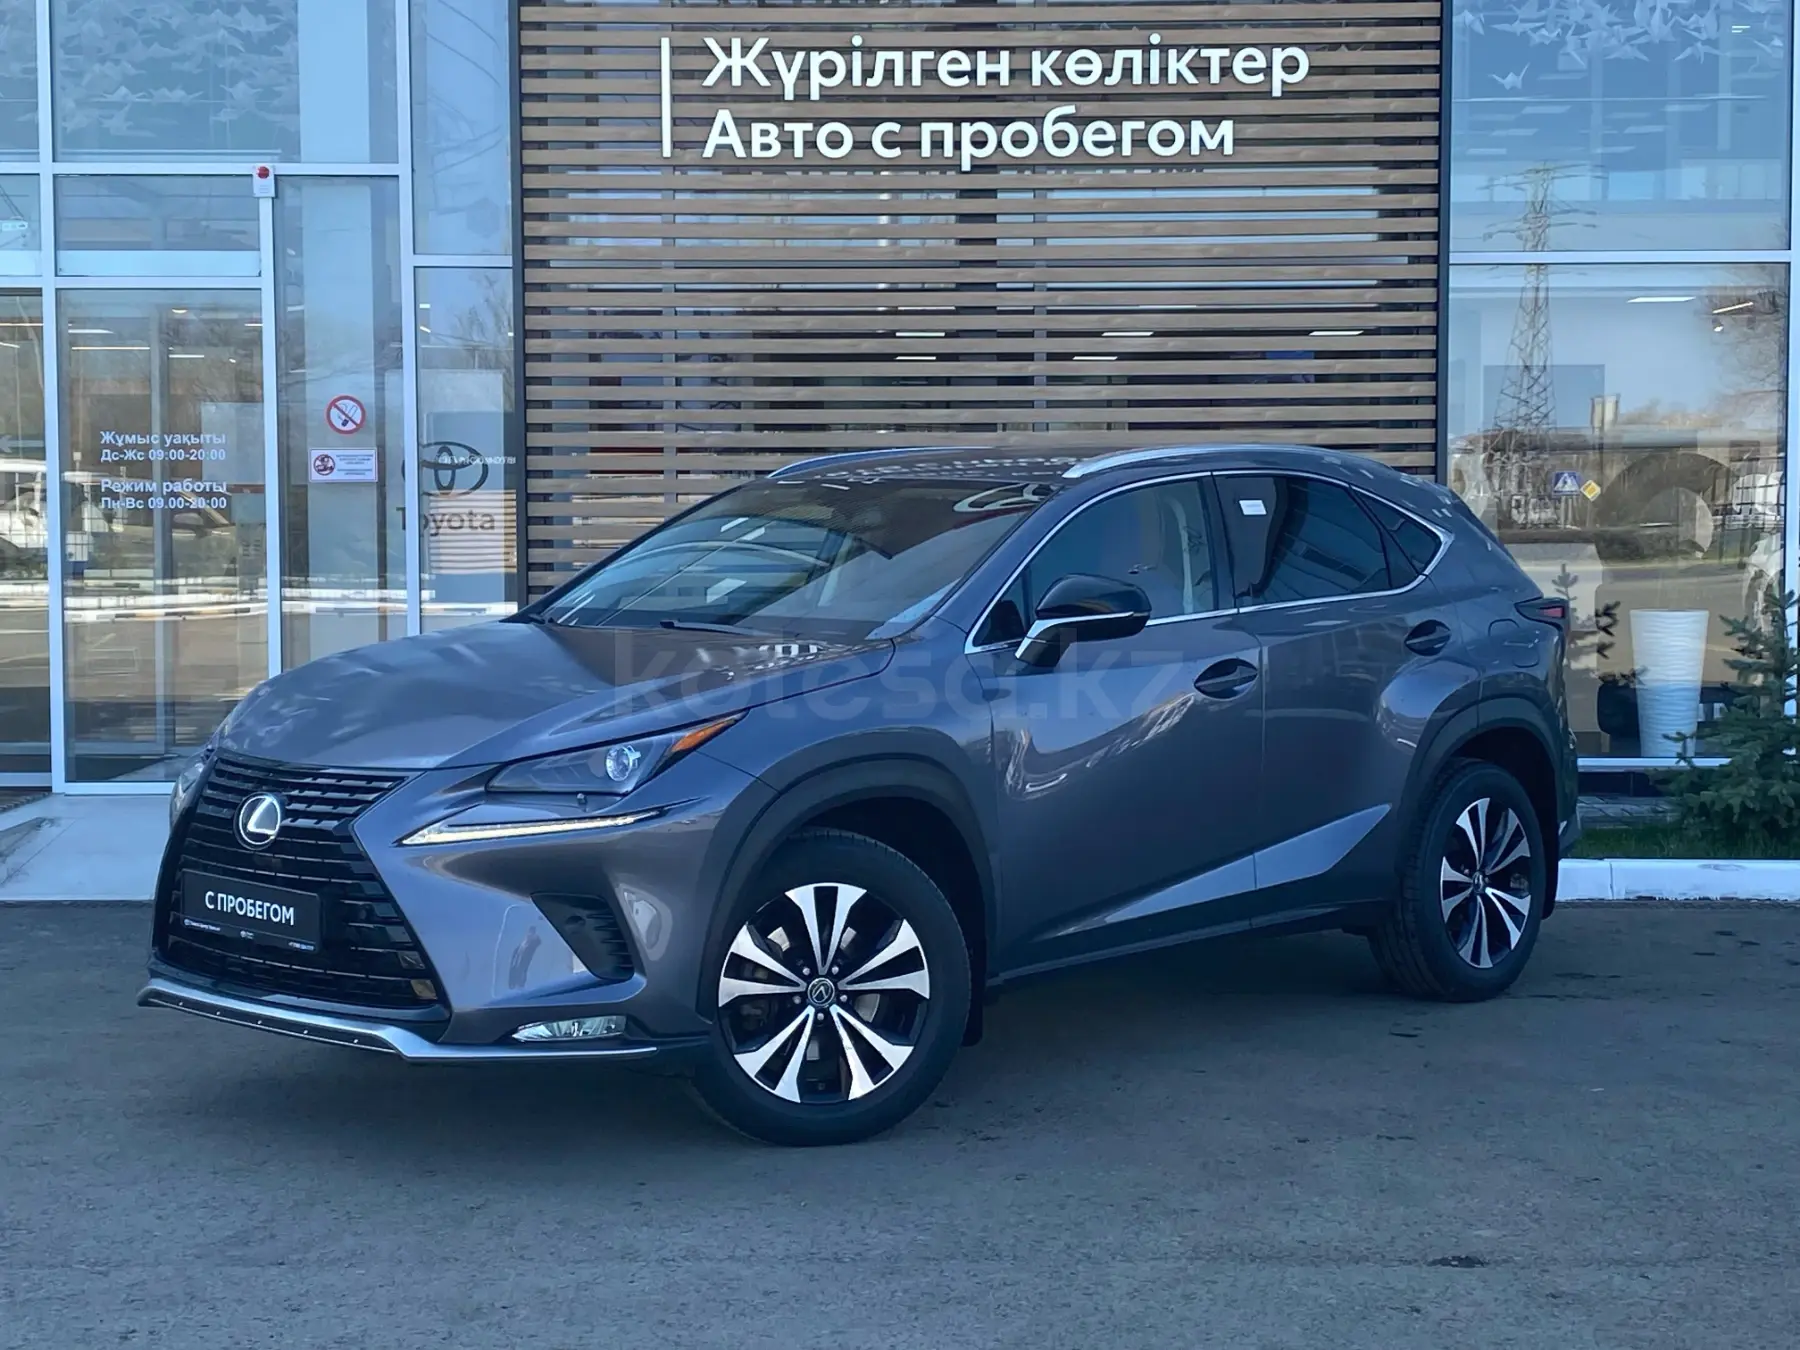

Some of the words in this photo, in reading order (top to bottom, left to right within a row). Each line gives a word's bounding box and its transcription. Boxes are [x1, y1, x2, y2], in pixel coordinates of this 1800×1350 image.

[701, 34, 1010, 101] Жүрілген
[1031, 32, 1310, 97] көліктер
[702, 108, 853, 159] Авто
[871, 121, 902, 159] с
[920, 104, 1235, 172] пробегом
[100, 431, 160, 447] Жұмыс
[164, 433, 226, 447] уақыты
[100, 449, 145, 462] Дс-Жс
[148, 449, 226, 461] 09:00-20:00
[101, 479, 157, 493] Режим
[163, 477, 227, 495] работы
[101, 497, 145, 509] Пн-Вс
[396, 506, 495, 537] Tyota
[205, 890, 215, 909] С
[217, 892, 295, 926] ПРОБЕГОМ
